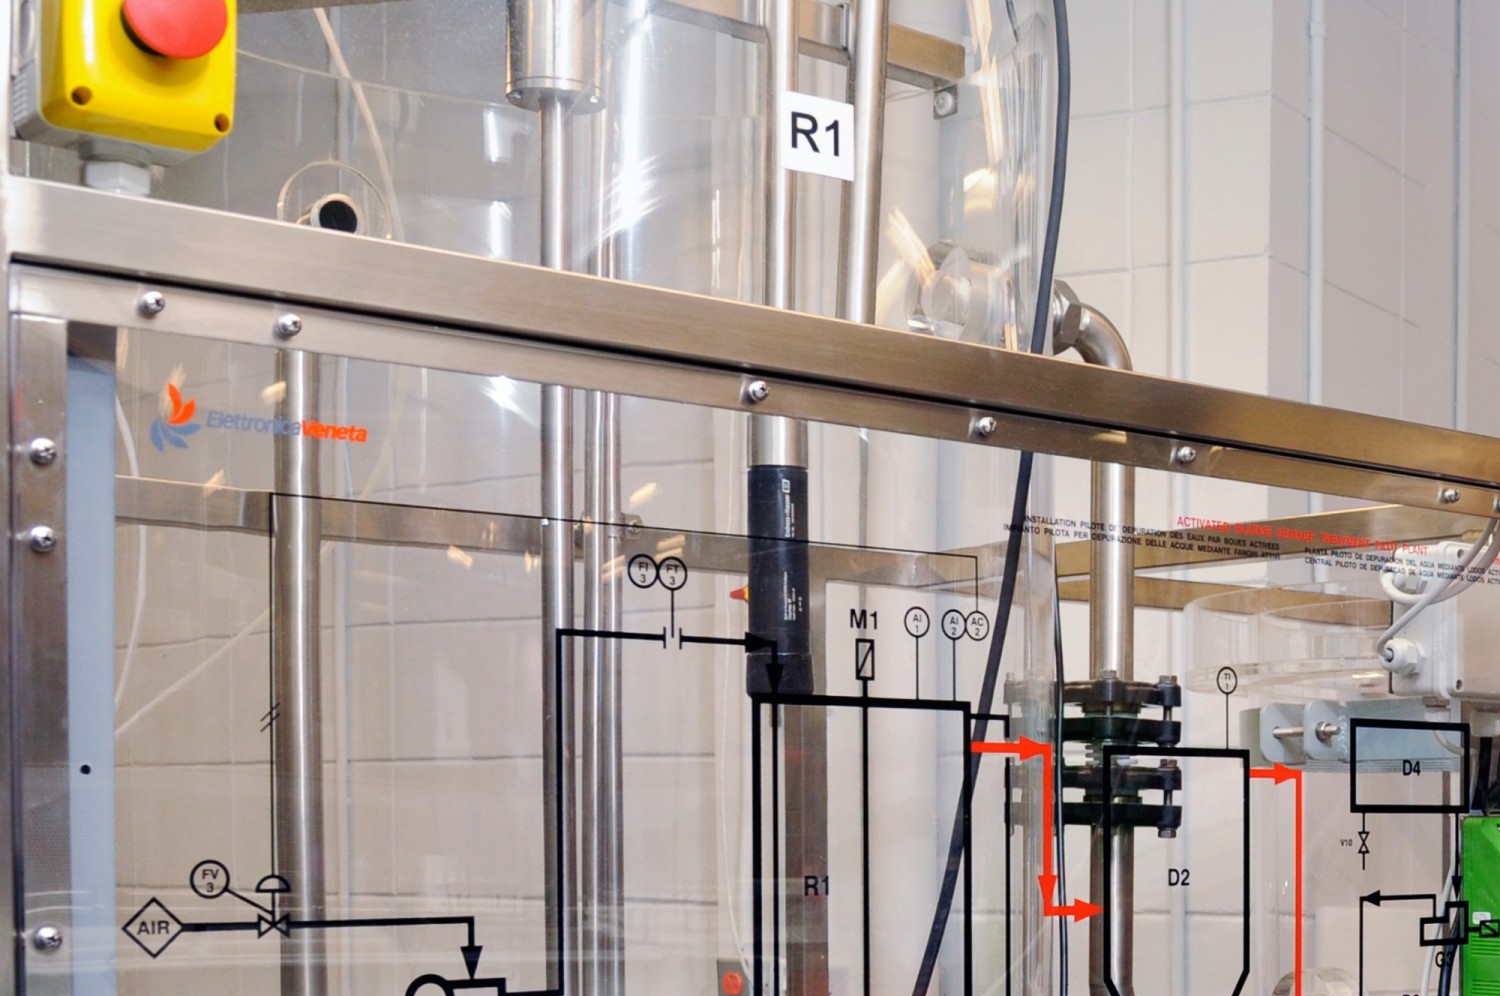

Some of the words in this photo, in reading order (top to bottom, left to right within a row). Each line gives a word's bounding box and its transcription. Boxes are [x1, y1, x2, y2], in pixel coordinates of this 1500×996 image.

[790, 110, 840, 157] R1
[1023, 515, 1076, 528] INSTALLATION
[1080, 521, 1104, 531] PILOTE
[1122, 525, 1167, 538] DEPURATION
[1170, 531, 1184, 540] DES
[1177, 516, 1230, 533] ACTIVATED
[1402, 543, 1428, 556] PLANT
[1044, 528, 1069, 538] PILOTA
[1073, 531, 1088, 540] PER
[1145, 538, 1167, 549] DELLE
[1170, 541, 1194, 551] ACQUE
[1197, 544, 1231, 556] MEDIANTE
[1331, 550, 1352, 560] PILOTO
[638, 562, 649, 572] FI
[666, 564, 679, 574] FT
[1335, 559, 1356, 569] PILOTO
[640, 573, 646, 583] 3
[669, 576, 676, 586] 3
[850, 608, 878, 630] M1
[971, 617, 984, 627] AC
[951, 627, 957, 636] 2
[974, 628, 980, 636] 2
[1402, 759, 1421, 777] D4
[1340, 838, 1353, 847] V10
[202, 868, 219, 880] FV
[1168, 868, 1190, 887] D2
[206, 882, 214, 893] 3
[804, 875, 829, 897] R1
[137, 920, 170, 936] AIR
